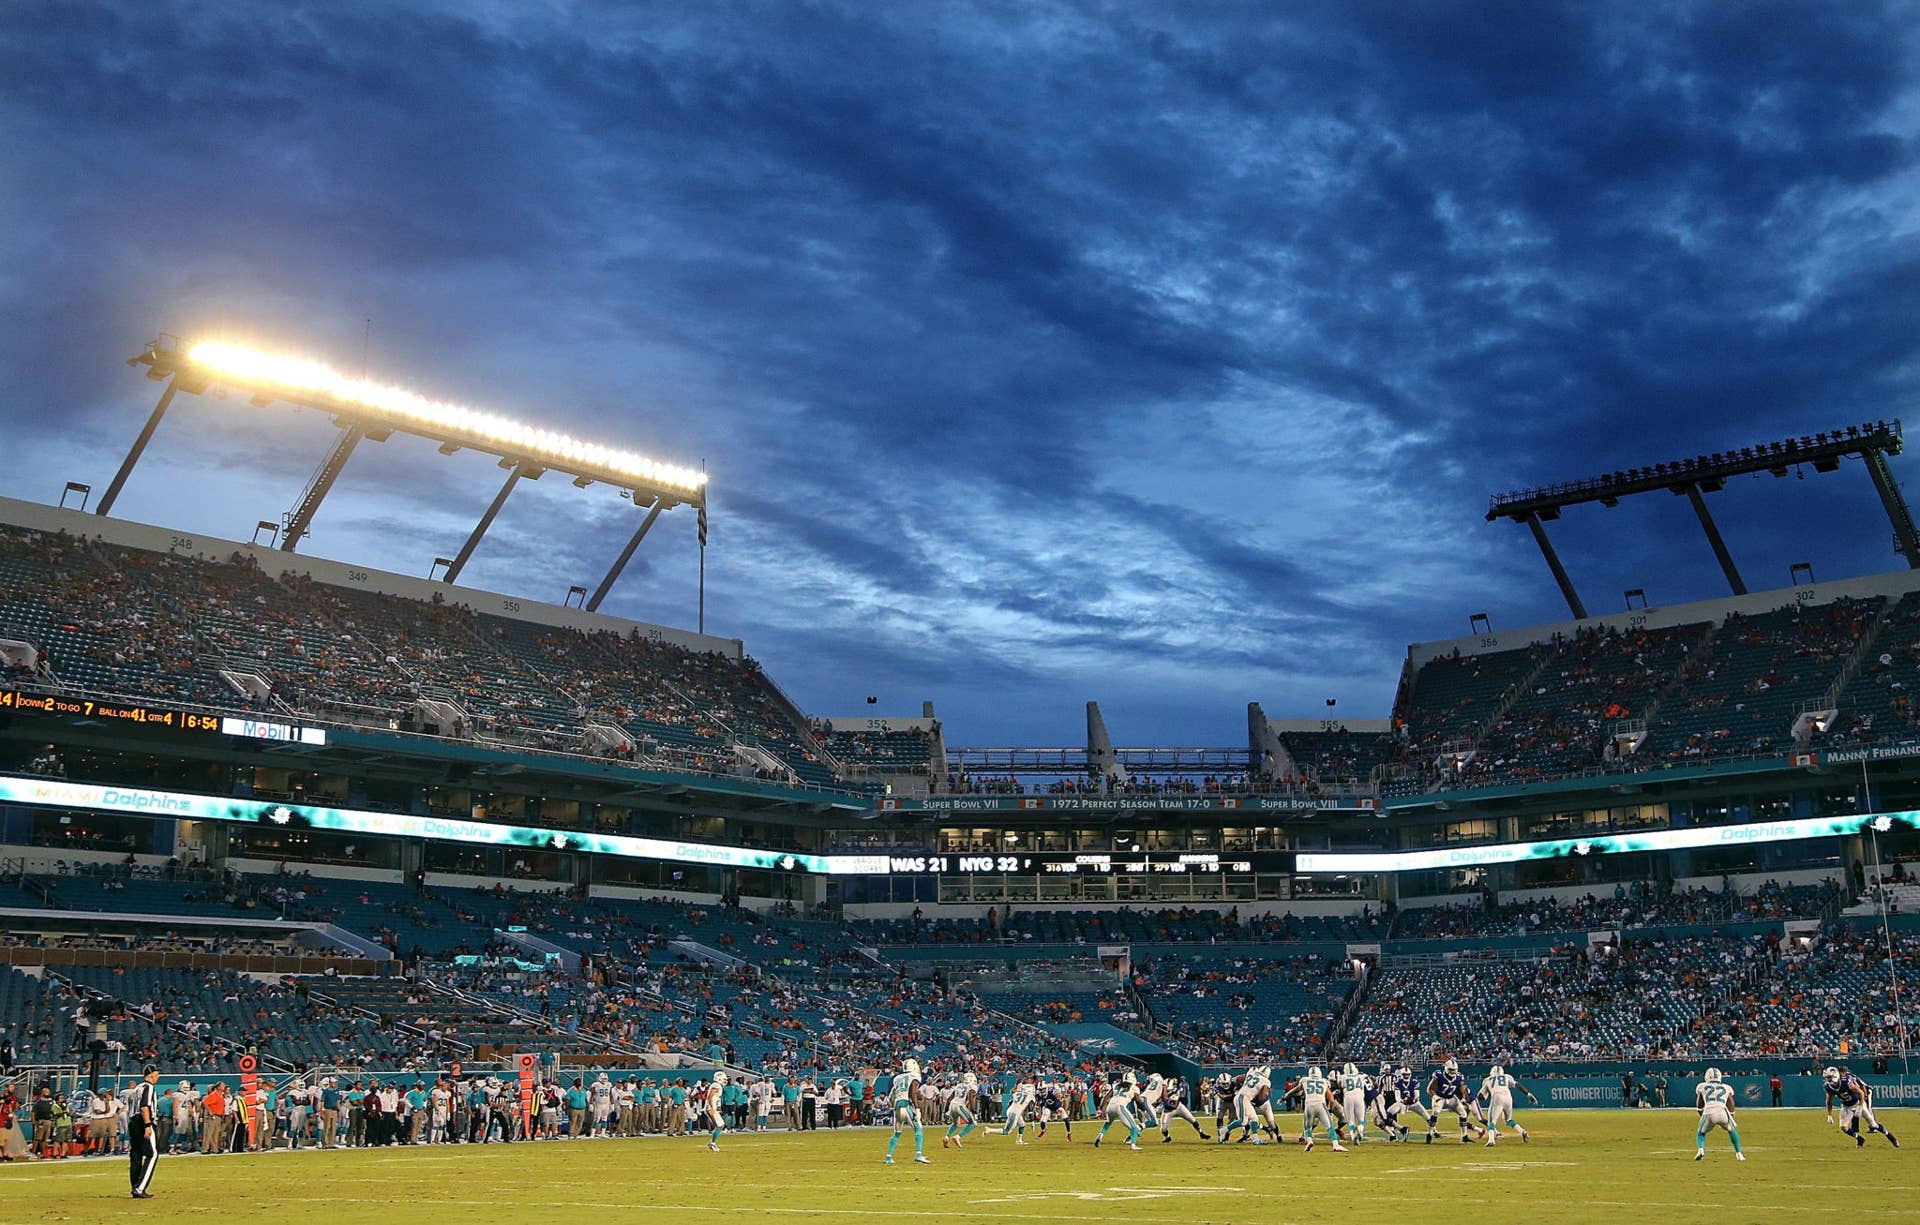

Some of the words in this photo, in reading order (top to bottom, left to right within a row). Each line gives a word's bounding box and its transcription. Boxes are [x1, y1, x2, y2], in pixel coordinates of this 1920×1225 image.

[171, 536, 192, 549] 348
[348, 570, 367, 583] 349
[1796, 590, 1815, 600] 302
[504, 600, 520, 612] 350
[1630, 615, 1646, 625] 301
[1480, 638, 1497, 647] 356
[20, 698, 44, 708] DOWN
[44, 698, 55, 711] 2
[56, 702, 66, 711] TO
[84, 702, 94, 715] 7
[99, 707, 118, 718] BALL
[119, 710, 131, 718] ON
[131, 708, 146, 722] 41
[163, 712, 172, 725] 4
[187, 715, 217, 731] 6:54
[867, 719, 887, 729] 352
[244, 720, 286, 740] Mobil
[292, 727, 299, 742] 1
[1828, 750, 1869, 763] MANNY
[103, 790, 191, 811] Dolphins
[984, 799, 999, 809] VII
[1052, 799, 1079, 809] 1972
[1187, 799, 1210, 809] 17-0
[1320, 799, 1338, 809] VIII
[891, 857, 925, 872] WAS
[928, 857, 947, 872] 21
[960, 857, 994, 872] NYG
[997, 857, 1018, 872] 32
[1046, 864, 1061, 872] 316
[1061, 864, 1077, 872] YDS
[1100, 864, 1111, 872] TD
[1170, 863, 1186, 872] YDS
[1208, 863, 1219, 872] TD
[452, 1064, 461, 1075] 2
[1490, 1075, 1507, 1087] 78
[1306, 1080, 1325, 1095] 55
[1442, 1084, 1456, 1096] 77
[1870, 1085, 1920, 1099] TRONGE
[1013, 1091, 1028, 1105] 31
[1704, 1084, 1727, 1104] 22
